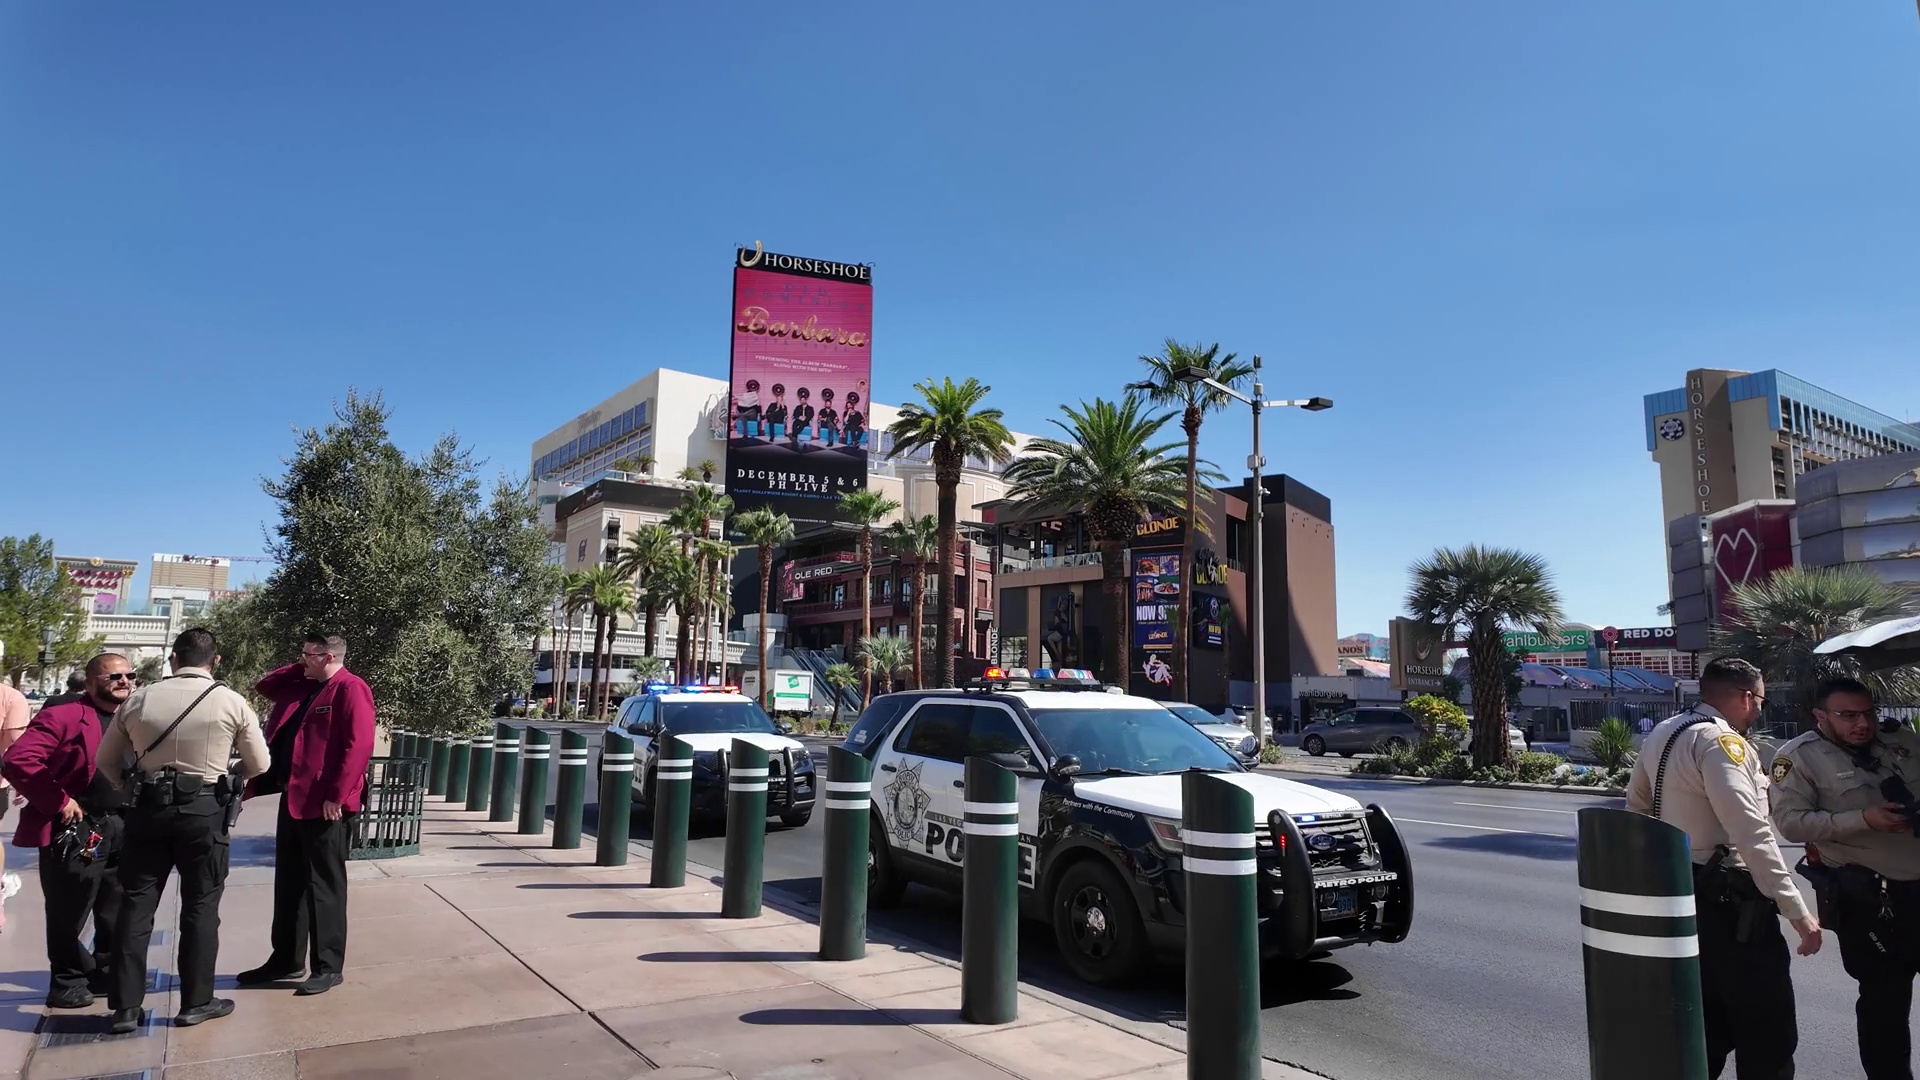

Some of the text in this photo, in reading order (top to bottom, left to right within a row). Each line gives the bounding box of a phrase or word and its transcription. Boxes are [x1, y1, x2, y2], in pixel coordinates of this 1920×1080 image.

[764, 253, 868, 280] HORSESHOE
[737, 306, 870, 347] Barbara
[1690, 377, 1710, 512] HORSESHOE
[737, 468, 858, 487] DECEMBER 5 & 6
[768, 480, 828, 493] PH LIVE
[794, 566, 833, 580] OLE RED
[1136, 605, 1156, 621] NOW
[1623, 627, 1678, 639] RED DO
[990, 626, 999, 665] BLONDE
[1406, 664, 1442, 676] HORSESHO
[1407, 677, 1435, 687] ENTRANCE
[1298, 689, 1344, 700] wahlburgers
[1062, 797, 1082, 808] Partners
[1093, 804, 1103, 812] the
[1103, 806, 1136, 820] Community
[934, 813, 946, 823] LAS
[893, 825, 915, 840] POLICE
[925, 822, 1033, 886] POE
[1313, 873, 1398, 889] METRO POLICE
[1868, 931, 1887, 954] OD KIT
